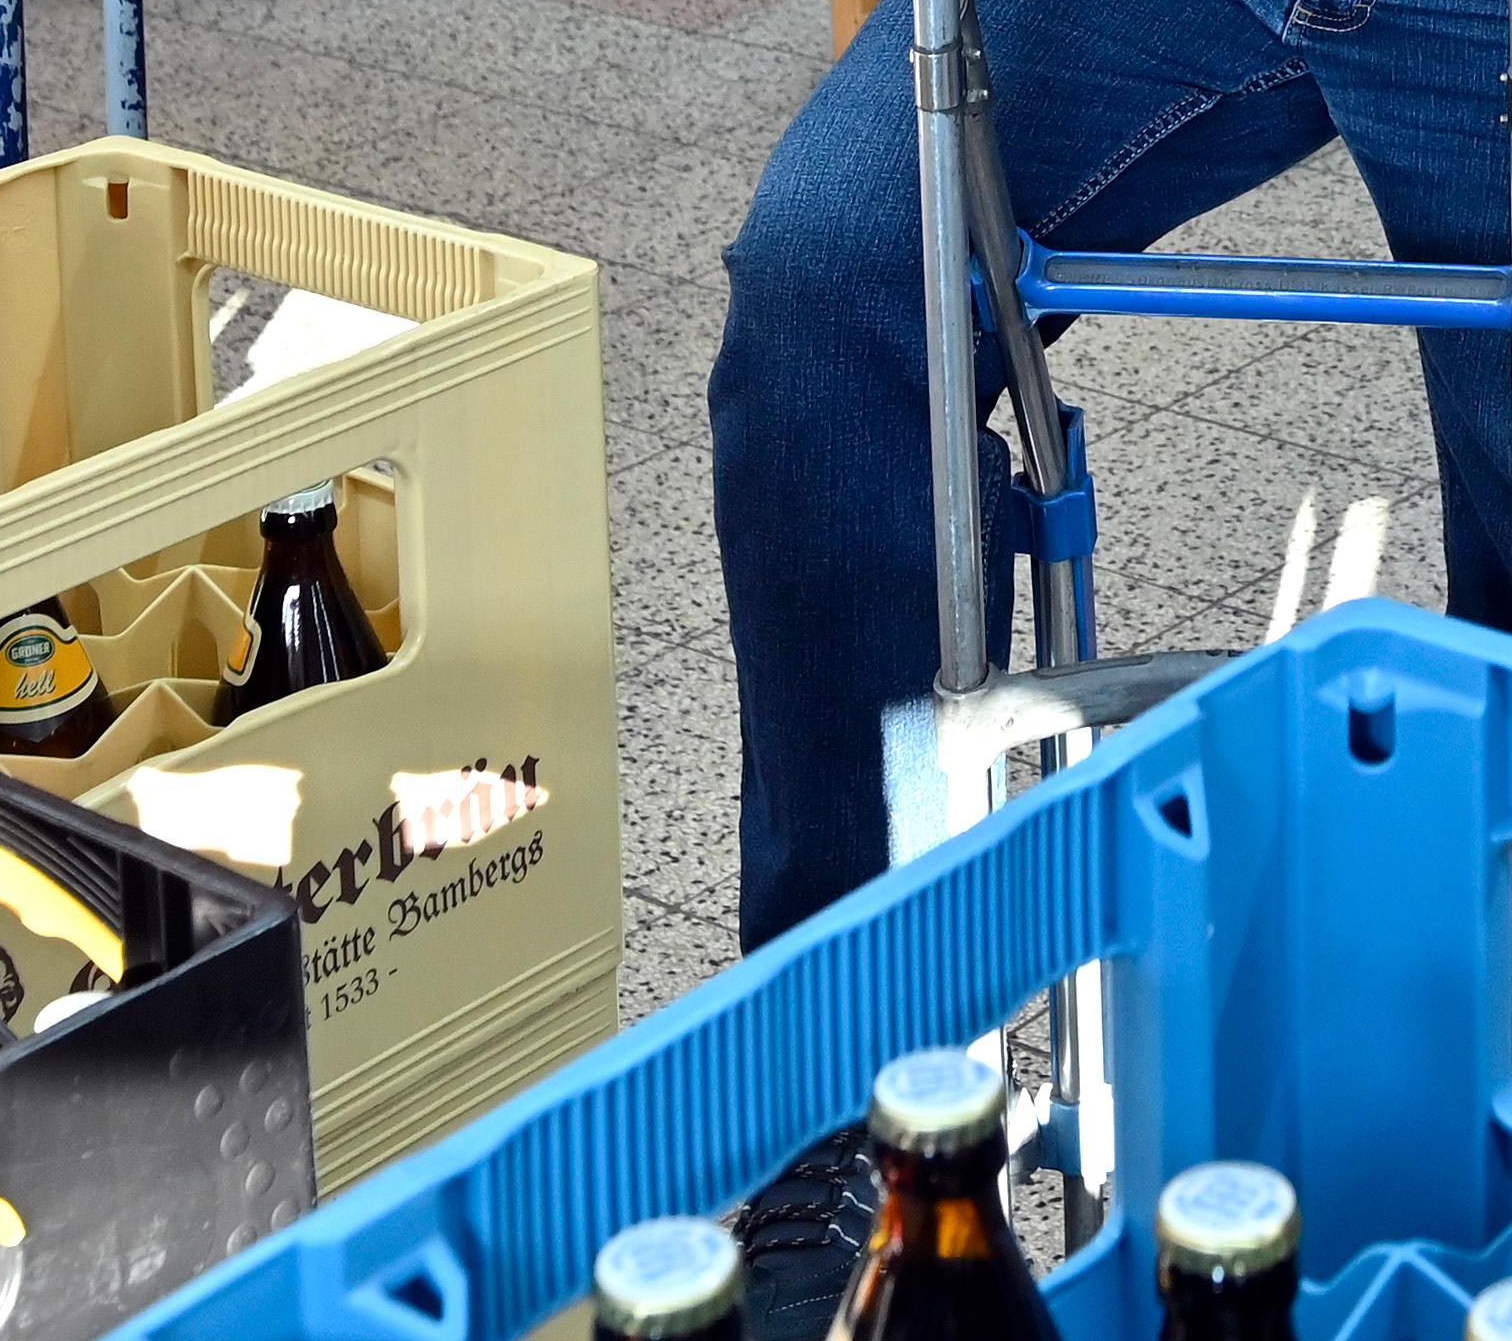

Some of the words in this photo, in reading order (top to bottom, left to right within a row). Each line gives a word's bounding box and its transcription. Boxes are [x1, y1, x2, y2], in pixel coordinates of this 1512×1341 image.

[15, 669, 57, 700] hell
[387, 829, 544, 941] Bambergs
[319, 967, 380, 1021] 1533
